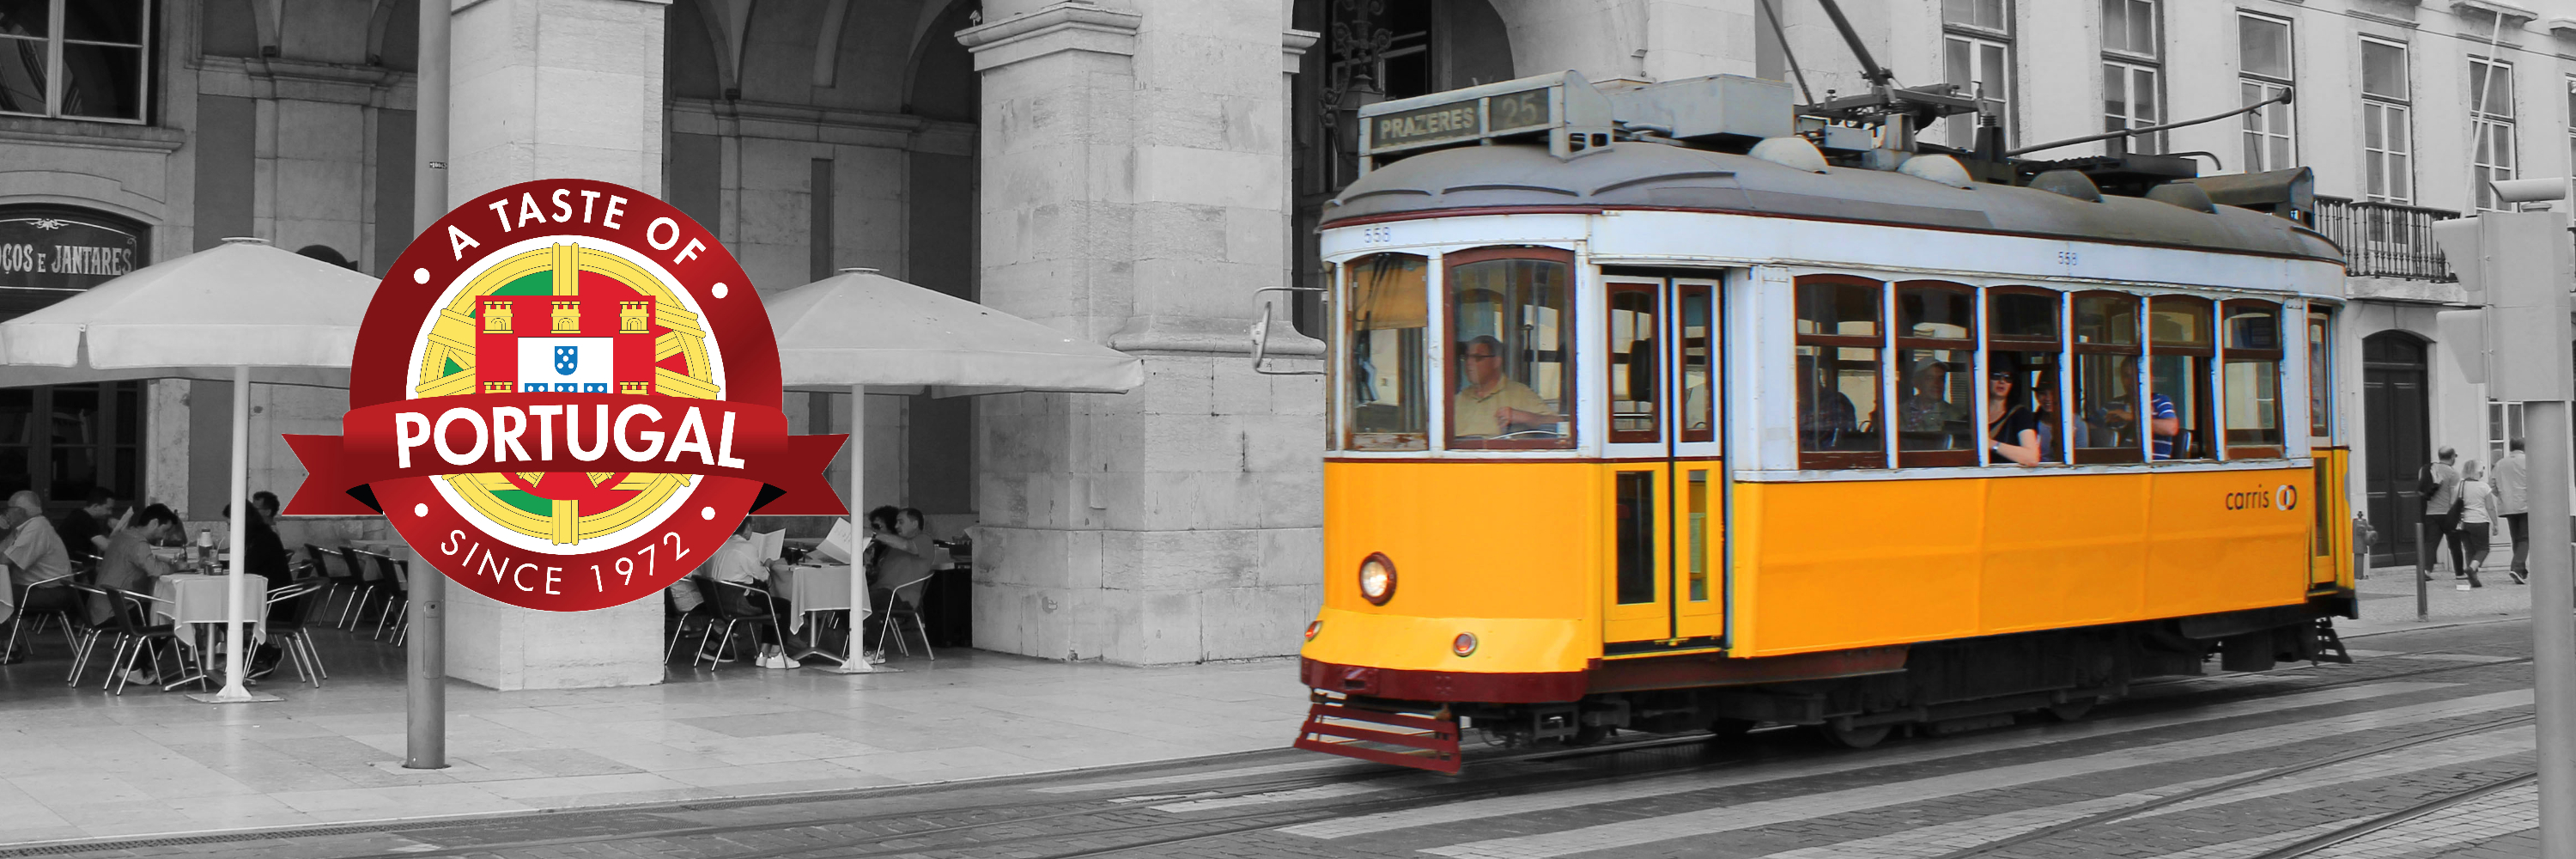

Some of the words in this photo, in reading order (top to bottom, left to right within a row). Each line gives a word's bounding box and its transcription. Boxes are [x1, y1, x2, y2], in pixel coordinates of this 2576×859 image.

[1380, 107, 1474, 140] PRAZERES
[1502, 93, 1539, 128] 25
[1364, 226, 1391, 243] 558
[0, 242, 33, 274] ÇOS
[37, 253, 46, 273] E
[51, 245, 132, 276] JANTARES
[2057, 251, 2077, 266] 558
[2225, 483, 2270, 511] carris
